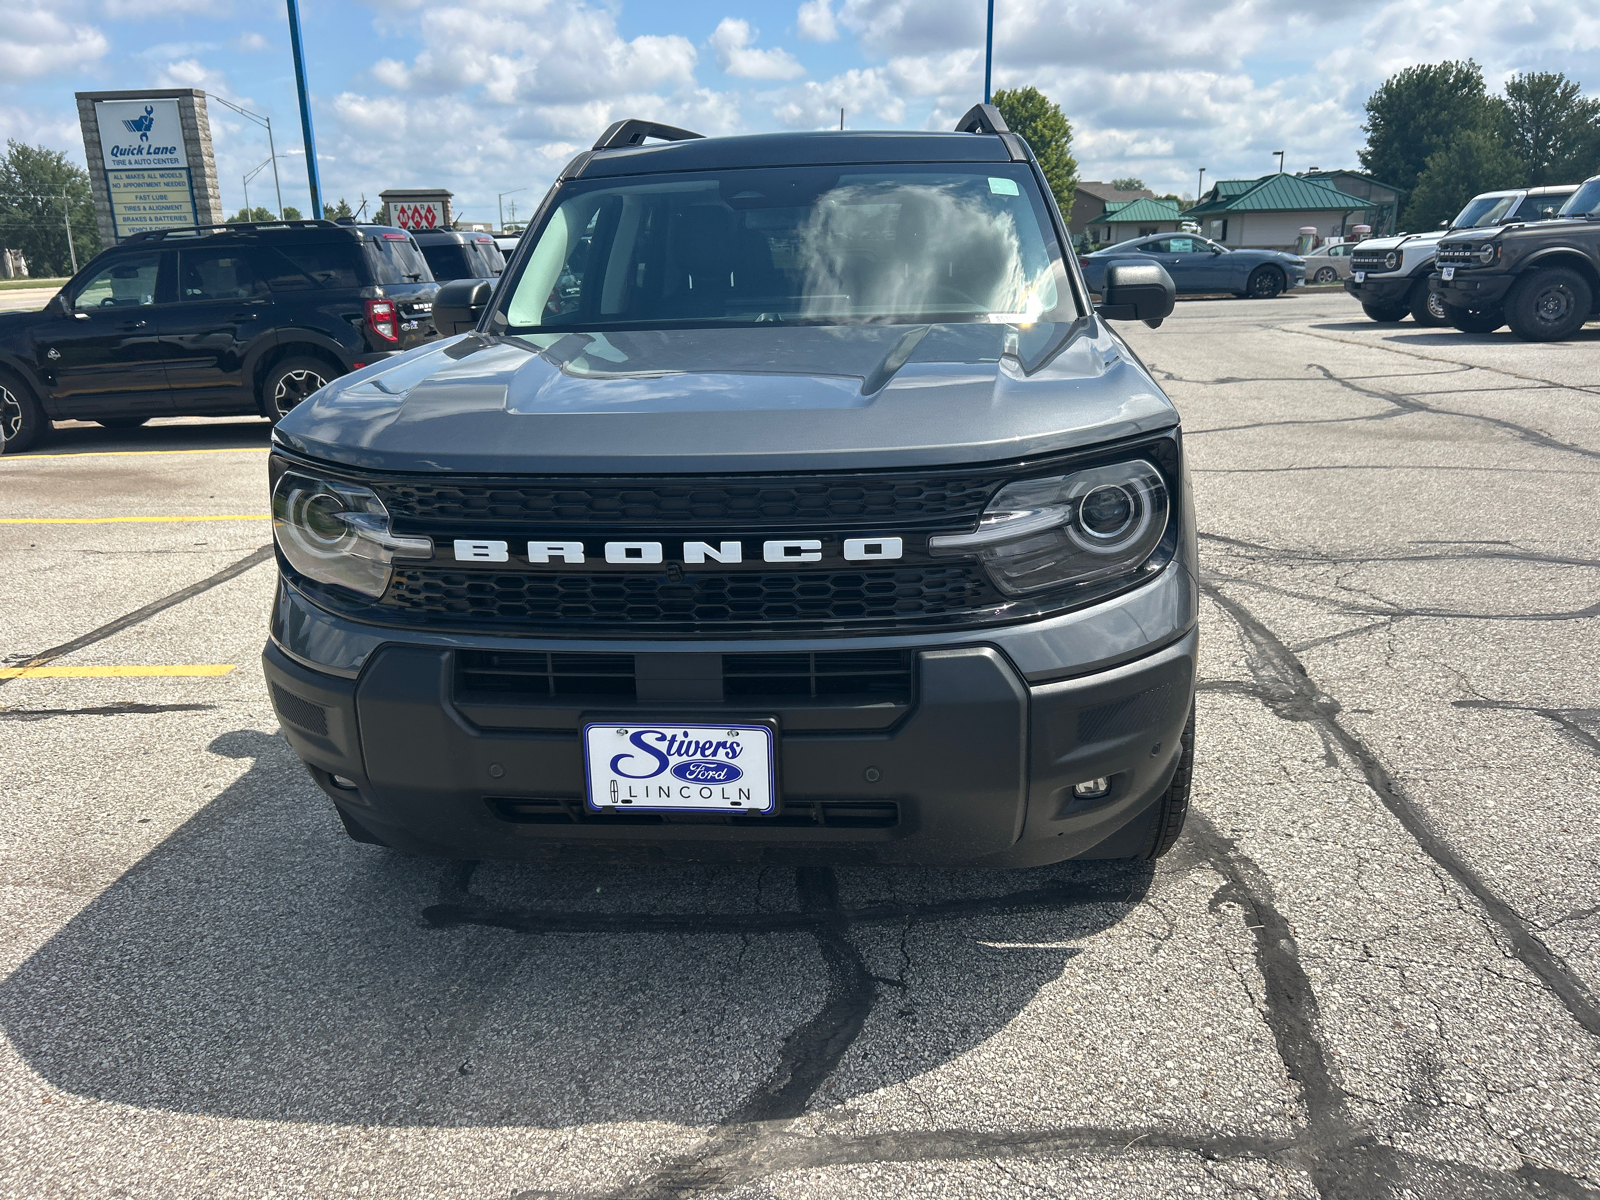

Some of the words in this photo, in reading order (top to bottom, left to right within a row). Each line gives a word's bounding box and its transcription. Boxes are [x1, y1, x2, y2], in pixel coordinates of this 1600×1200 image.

[110, 144, 144, 157] Quick
[146, 144, 176, 155] Lane
[400, 212, 433, 222] MAY
[454, 537, 902, 564] BRONCO
[610, 730, 743, 779] Stivers
[686, 762, 728, 780] Ford
[628, 786, 750, 800] LINCOLN
